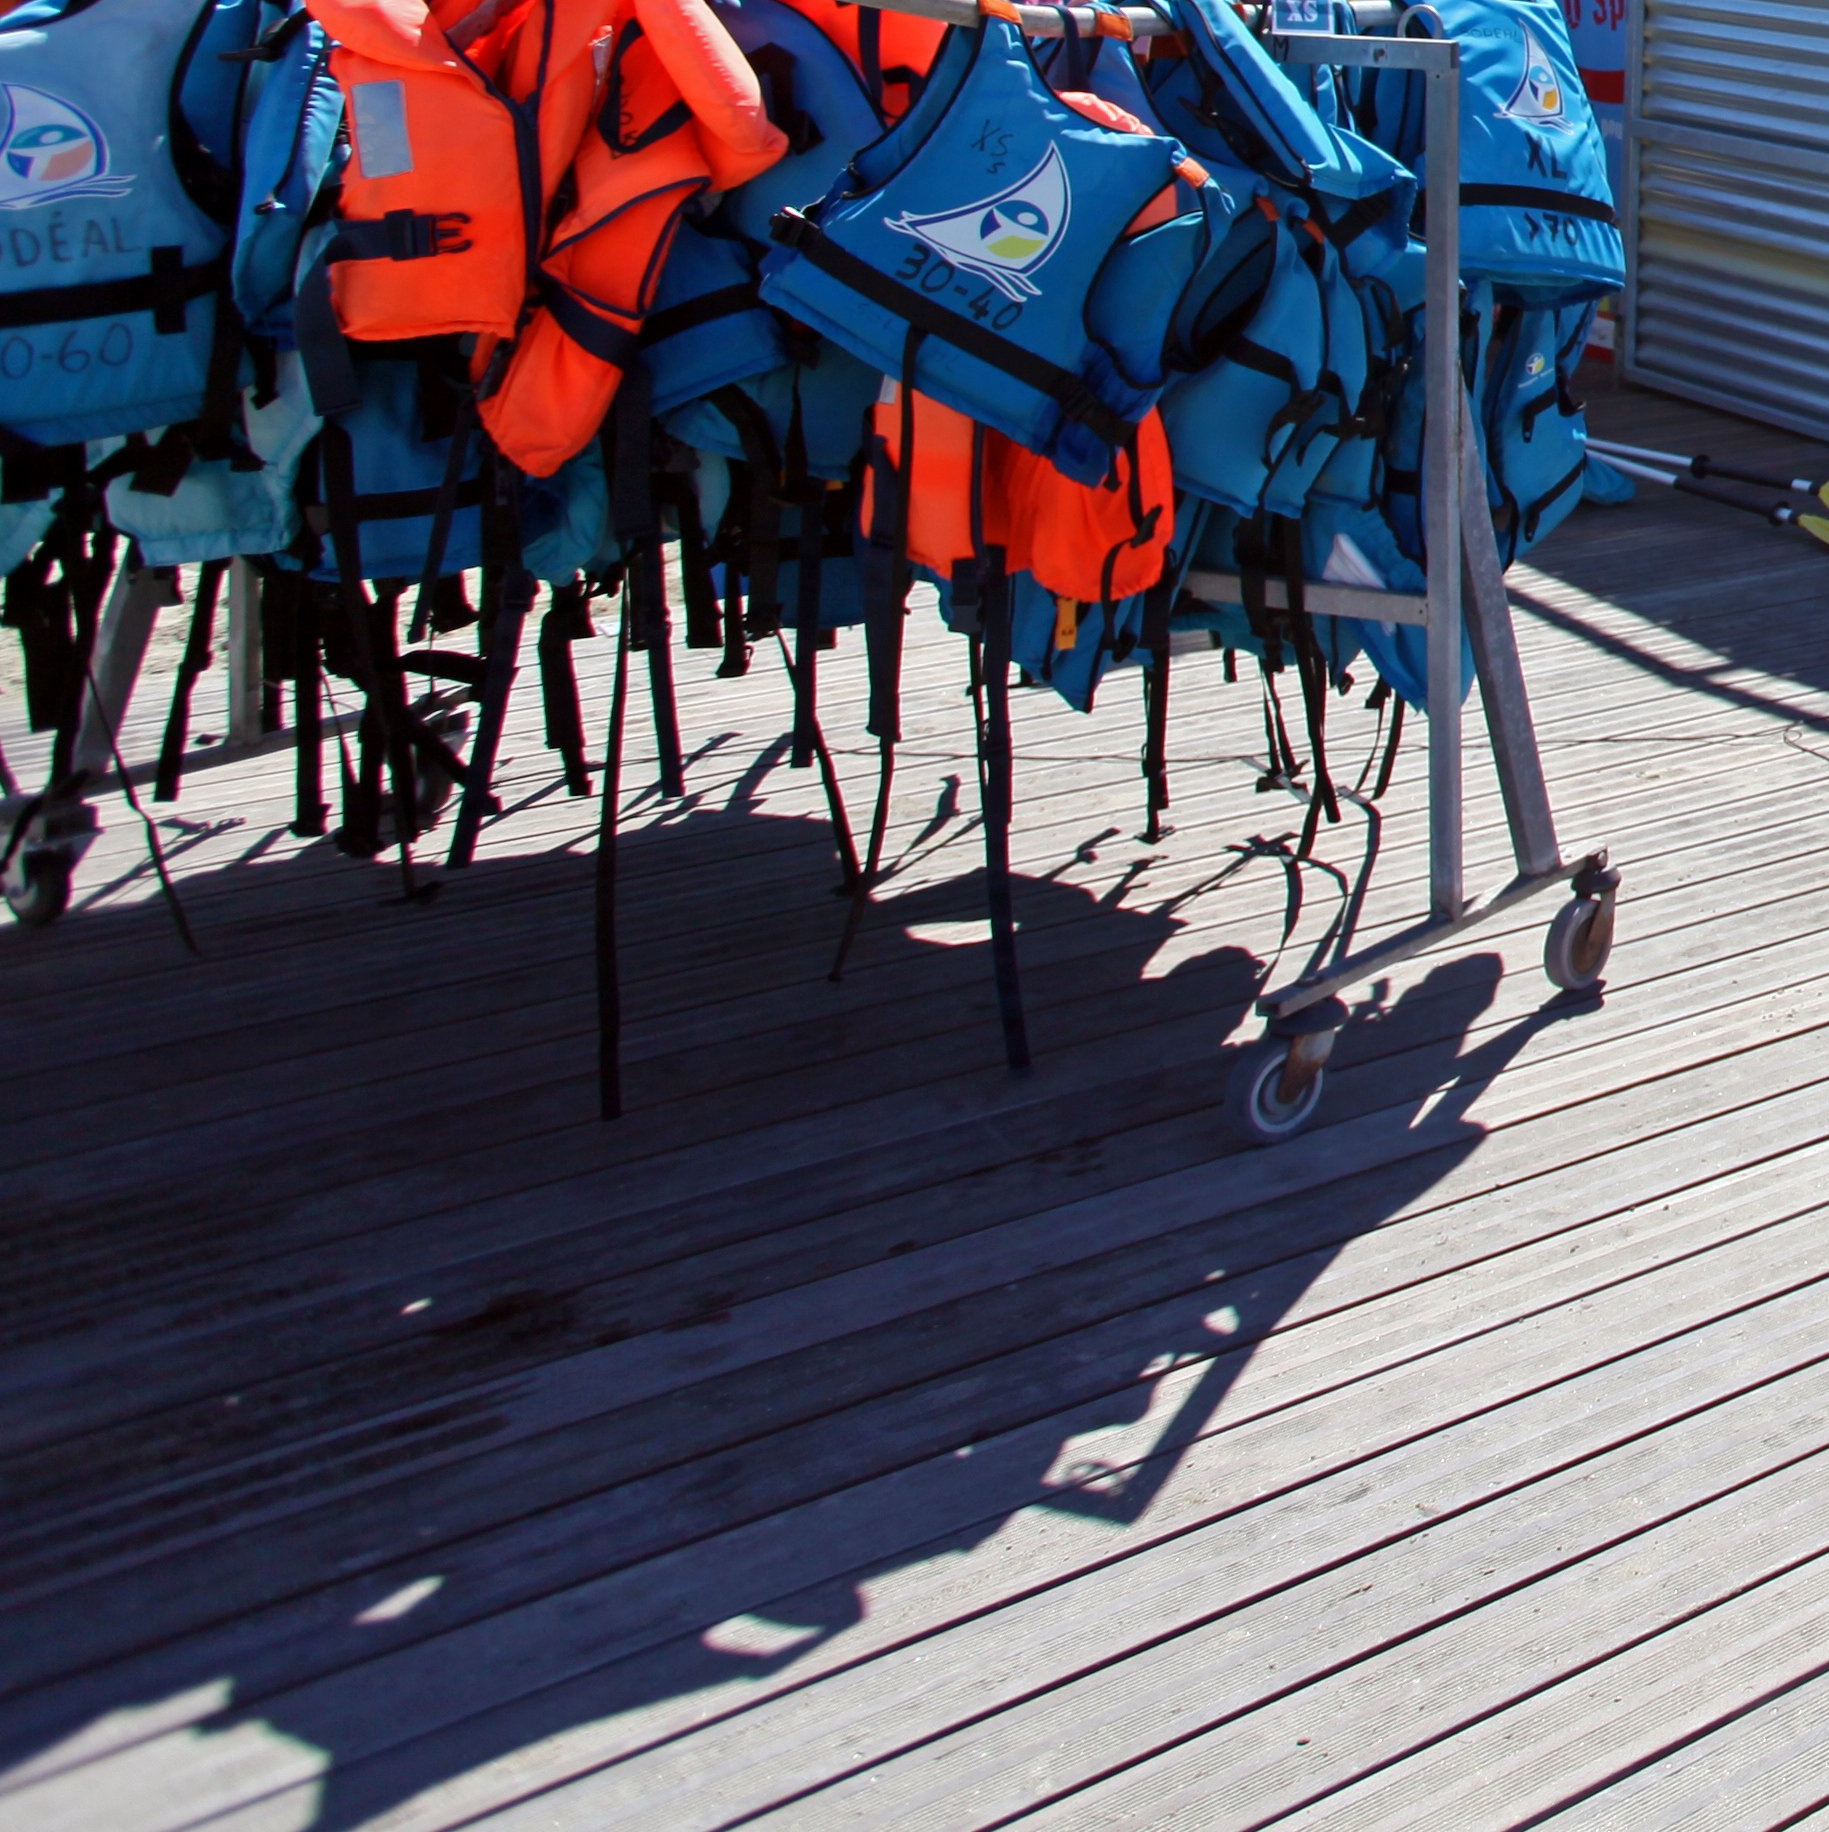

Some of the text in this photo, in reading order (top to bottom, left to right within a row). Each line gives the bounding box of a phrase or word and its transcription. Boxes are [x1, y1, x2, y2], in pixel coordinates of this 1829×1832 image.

[971, 119, 1017, 158] XS
[1525, 131, 1568, 180] XL
[0, 210, 141, 268] DÉAL
[895, 243, 1027, 331] 30-40
[0, 321, 134, 381] 0-60
